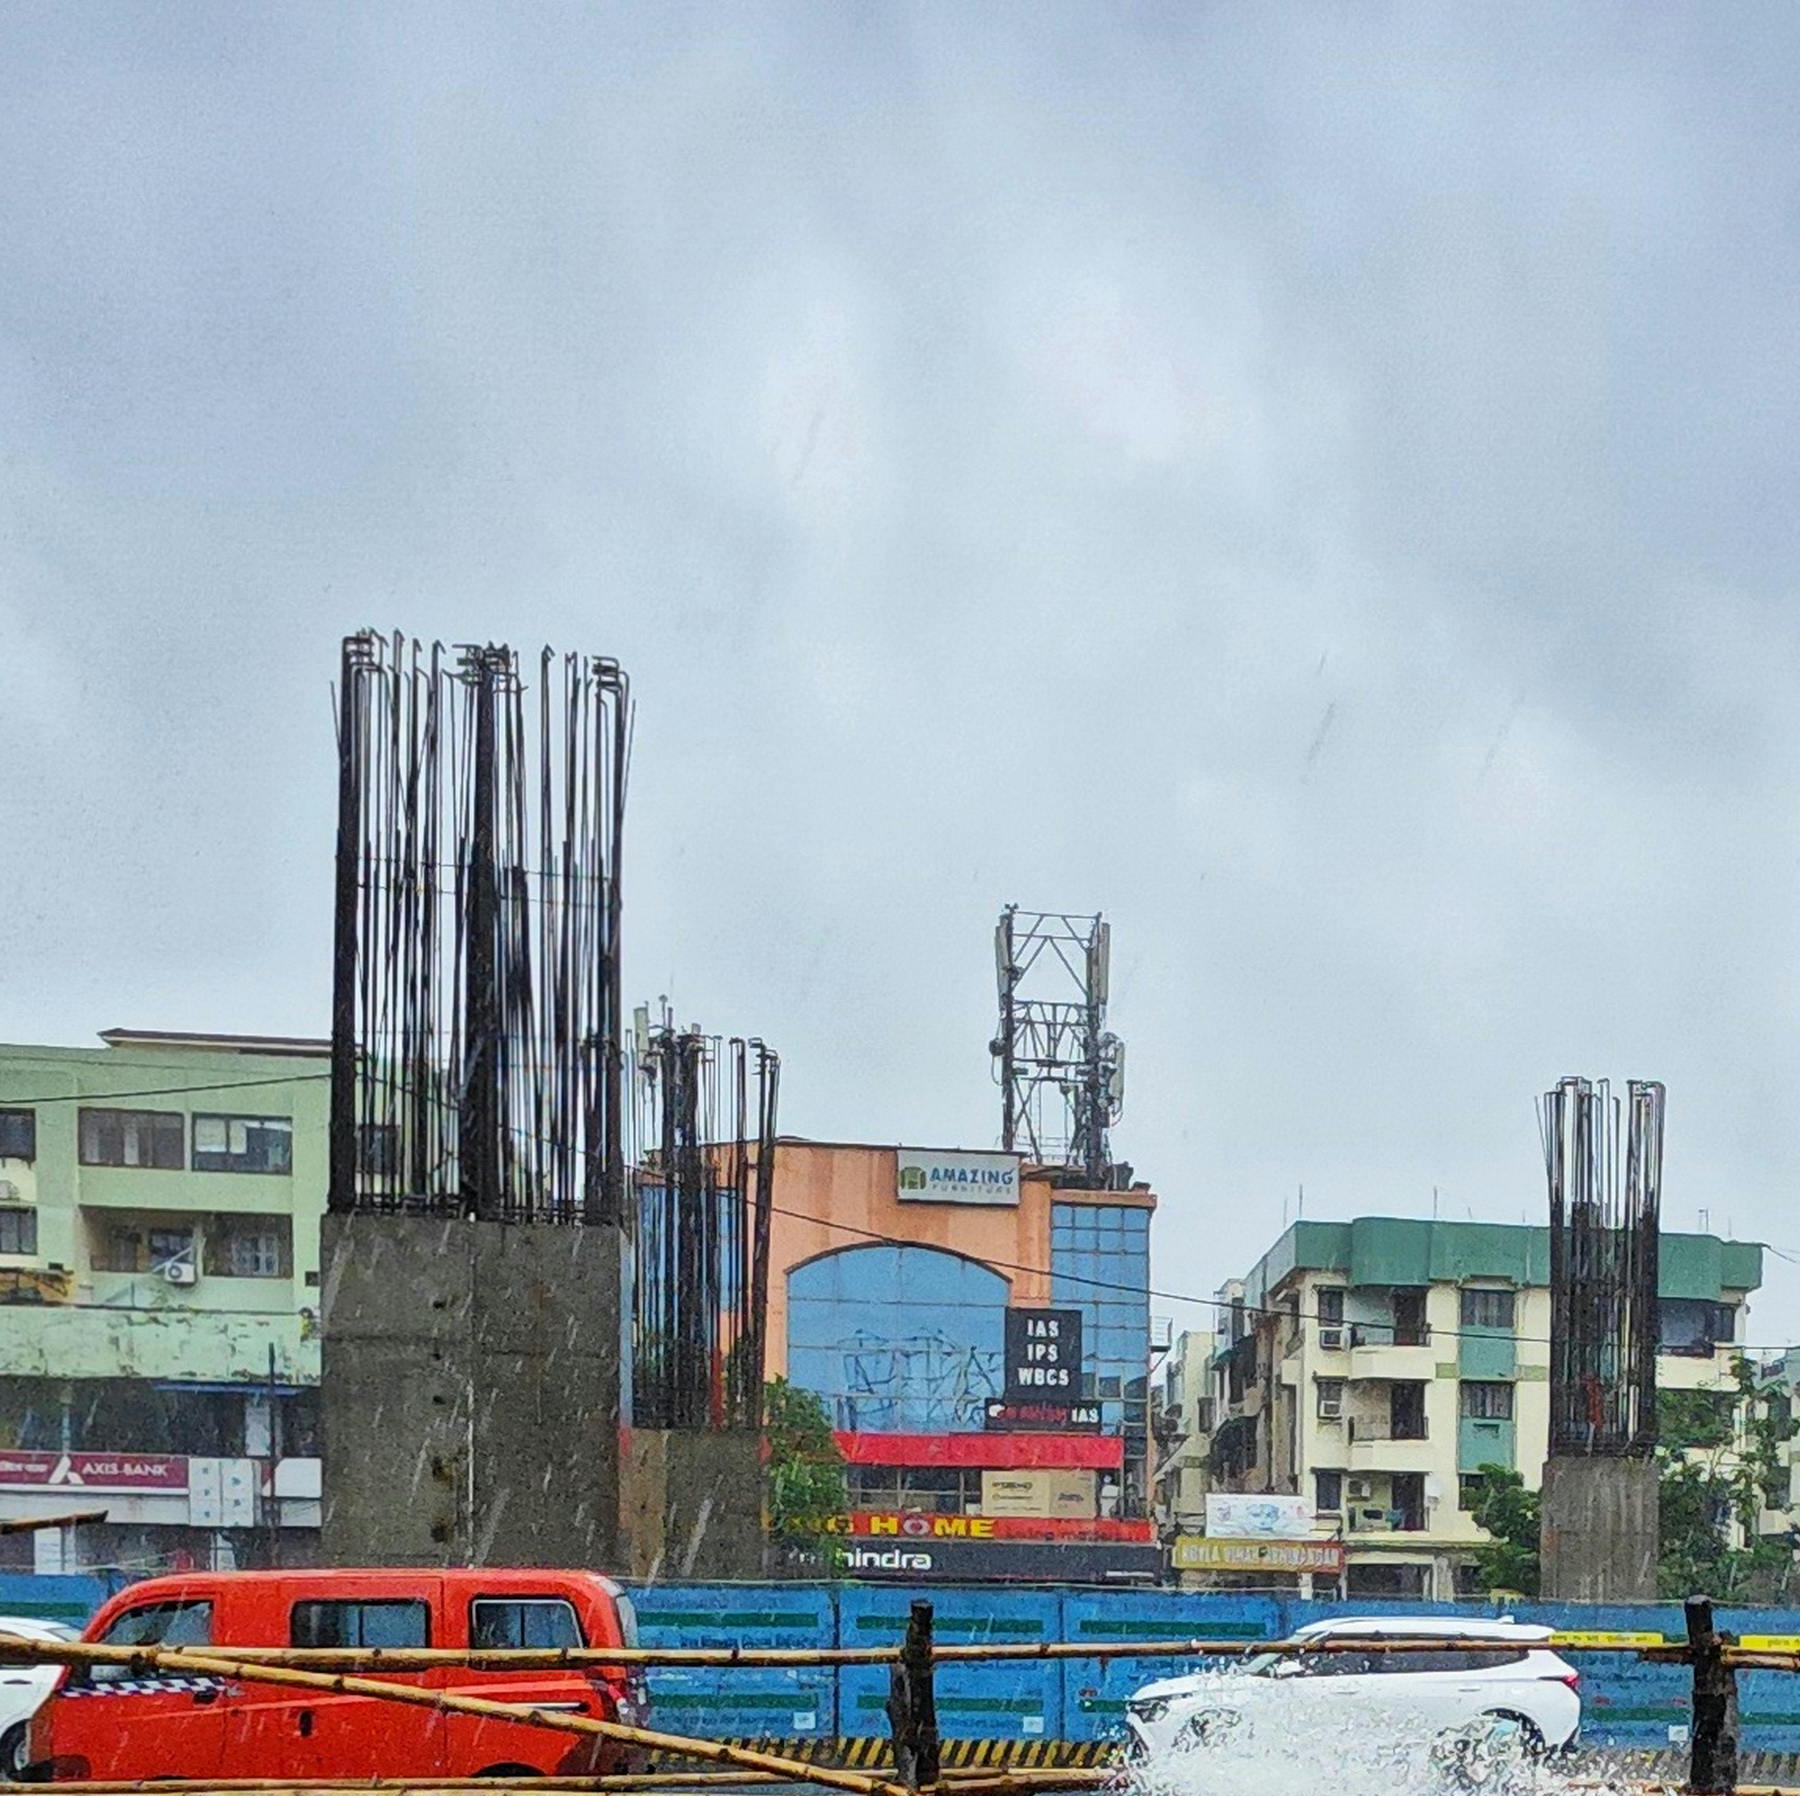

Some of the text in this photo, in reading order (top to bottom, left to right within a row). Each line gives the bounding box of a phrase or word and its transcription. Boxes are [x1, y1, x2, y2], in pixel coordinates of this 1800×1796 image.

[930, 1167, 1015, 1185] AMAZING
[1026, 1318, 1060, 1338] IAS
[1026, 1343, 1058, 1362] IPS
[1017, 1367, 1070, 1386] WBCS
[1071, 1407, 1099, 1423] IAS
[82, 1462, 167, 1477] AXIS BANK
[870, 1514, 996, 1538] HOME
